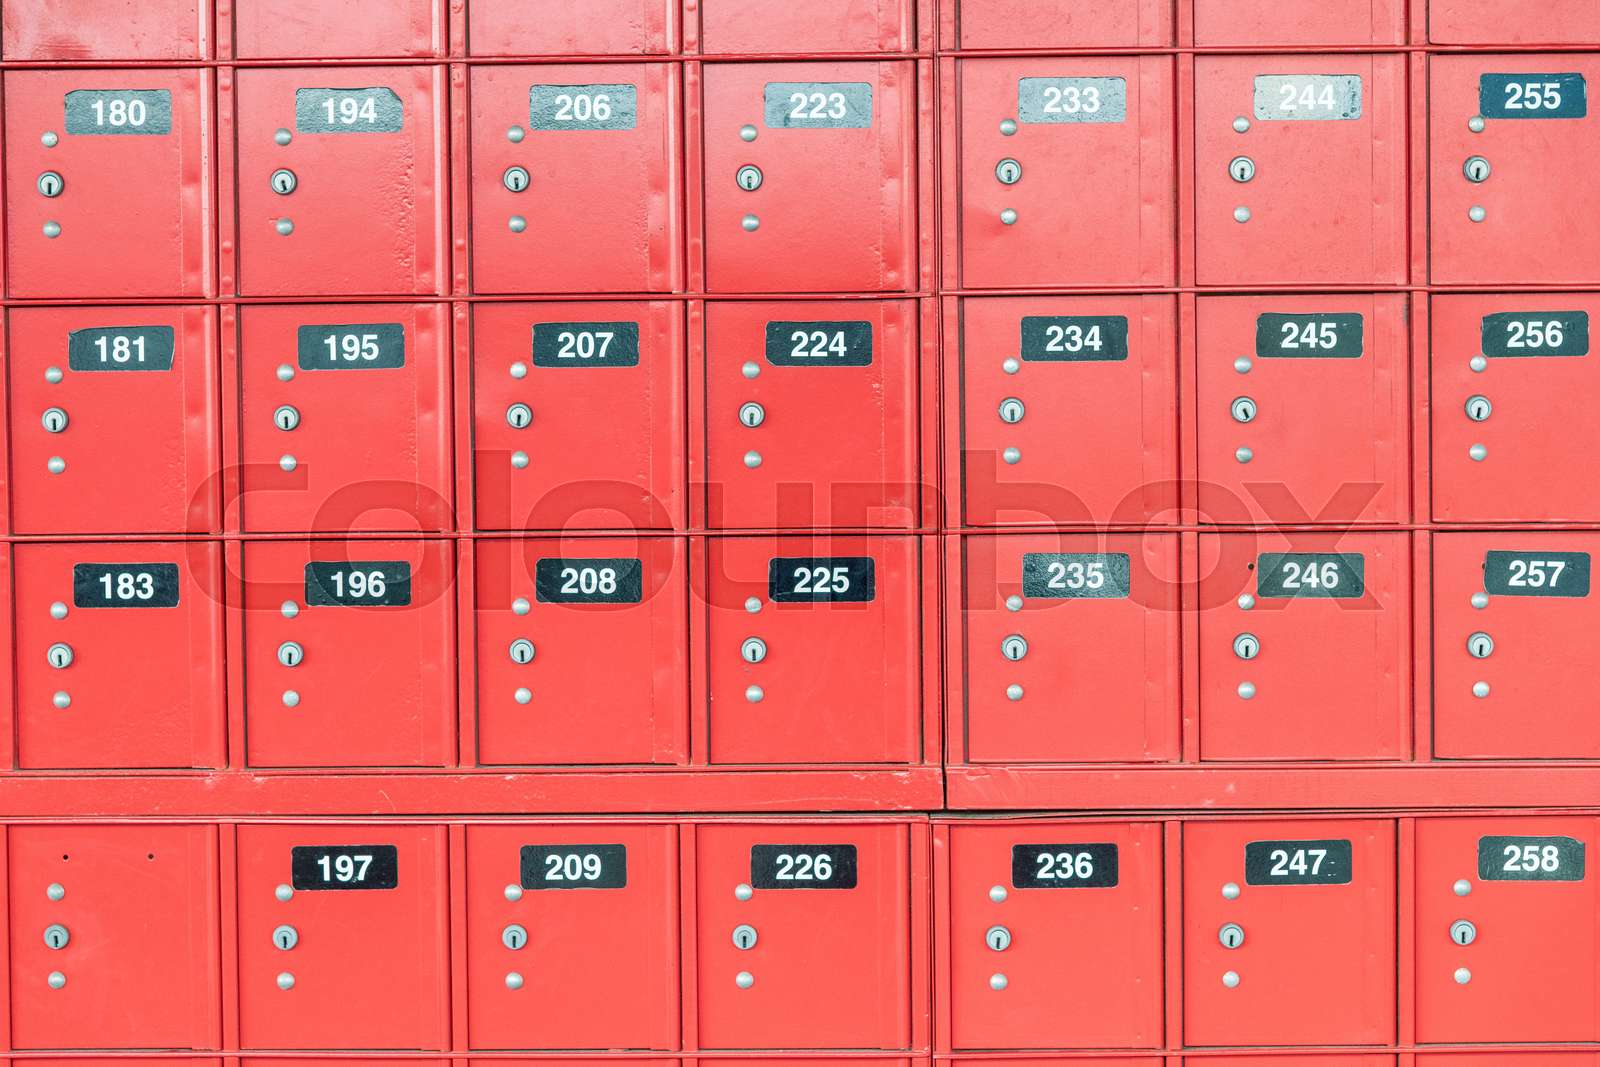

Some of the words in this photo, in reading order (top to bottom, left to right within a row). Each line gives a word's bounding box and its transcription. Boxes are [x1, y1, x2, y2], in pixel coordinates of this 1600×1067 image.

[321, 95, 378, 125] 194
[554, 93, 612, 121] 206
[789, 92, 847, 119] 223
[1043, 86, 1101, 114] 233
[1278, 82, 1337, 111] 244
[1504, 82, 1562, 110] 255
[91, 98, 147, 127] 180
[323, 334, 380, 361] 195
[557, 331, 614, 359] 207
[790, 330, 847, 357] 224
[1045, 325, 1103, 352] 234
[1279, 321, 1338, 349] 245
[1506, 320, 1564, 348] 256
[94, 335, 145, 363] 181
[99, 572, 154, 600] 183
[330, 570, 386, 598] 196
[560, 567, 617, 595] 208
[793, 566, 850, 593] 225
[1047, 561, 1105, 589] 235
[1282, 561, 1339, 589] 246
[1508, 559, 1566, 588] 257
[317, 854, 373, 882] 197
[545, 853, 602, 881] 209
[775, 853, 833, 881] 226
[1036, 852, 1094, 879] 236
[1270, 849, 1327, 876] 247
[1502, 844, 1560, 872] 258
